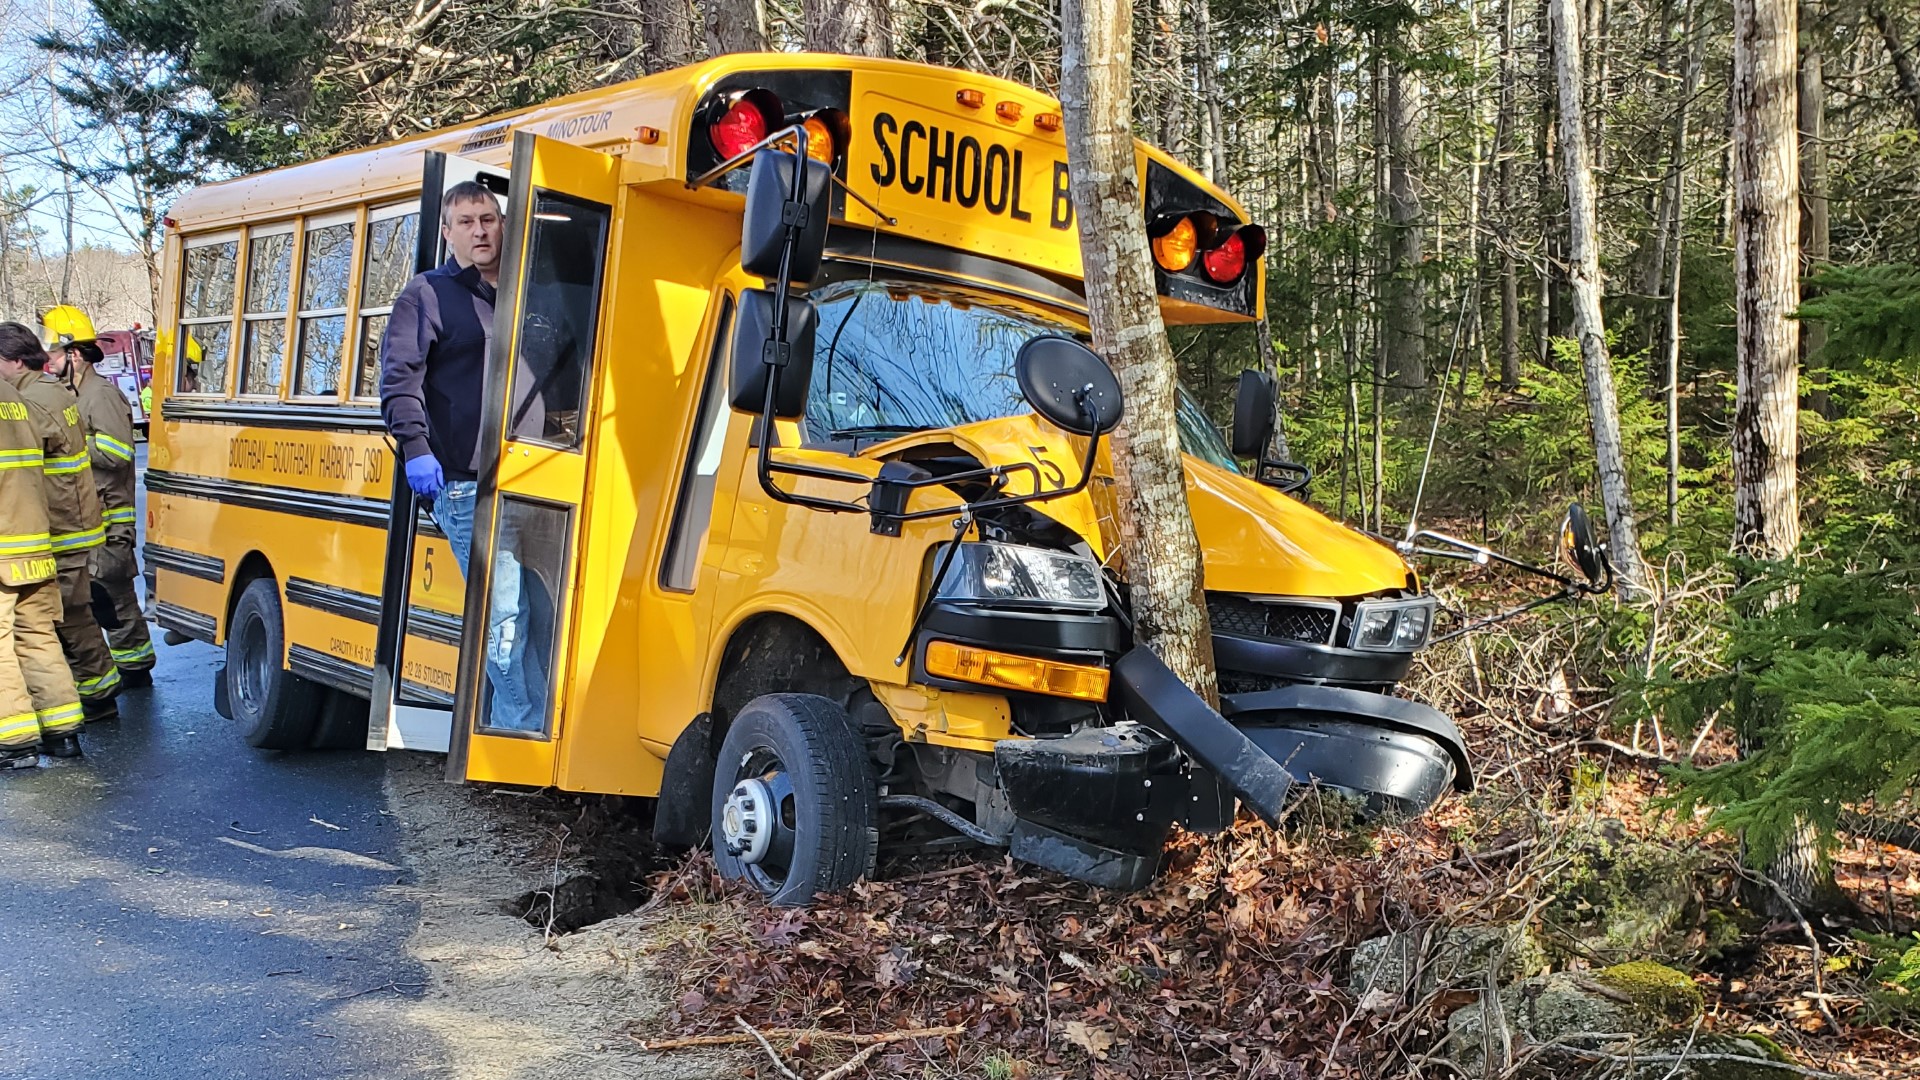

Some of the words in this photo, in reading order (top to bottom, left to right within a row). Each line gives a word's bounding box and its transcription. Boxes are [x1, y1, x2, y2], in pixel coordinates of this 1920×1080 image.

[546, 111, 613, 140] MINOTOUR
[870, 112, 1031, 223] SCHOOL
[1028, 446, 1066, 489] 5
[11, 563, 24, 581] A
[423, 547, 434, 592] 5
[424, 665, 452, 689] STUDENTS
